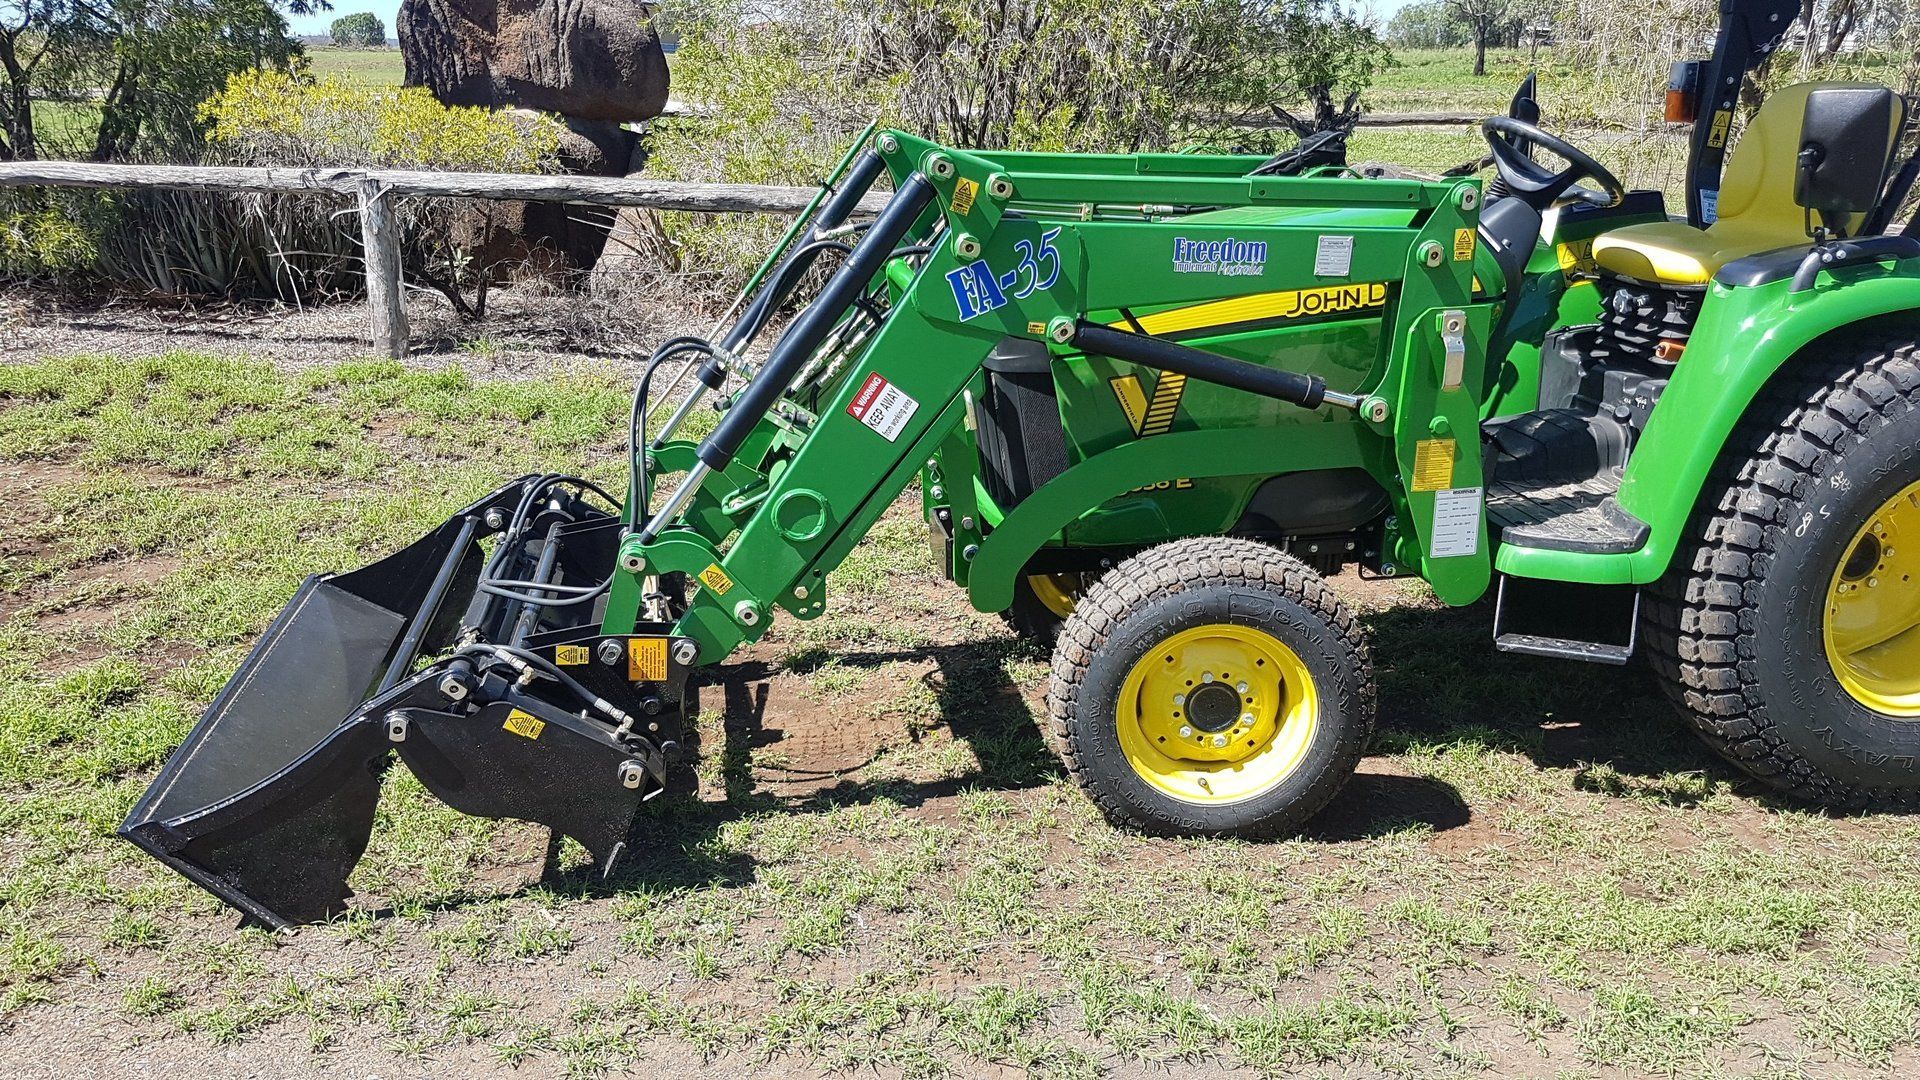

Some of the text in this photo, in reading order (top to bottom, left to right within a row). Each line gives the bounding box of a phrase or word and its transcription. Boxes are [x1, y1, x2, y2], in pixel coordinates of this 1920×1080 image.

[1172, 237, 1268, 263] Freedom
[945, 226, 1062, 322] FA-35
[1286, 287, 1361, 316] JOHN
[857, 377, 882, 407] WARNING
[867, 387, 900, 429] KEEP AWAY
[1115, 382, 1138, 424] VANDERFIELD
[882, 398, 913, 437] from working area
[1274, 608, 1350, 715] GALAXY
[1089, 697, 1106, 757] MOW
